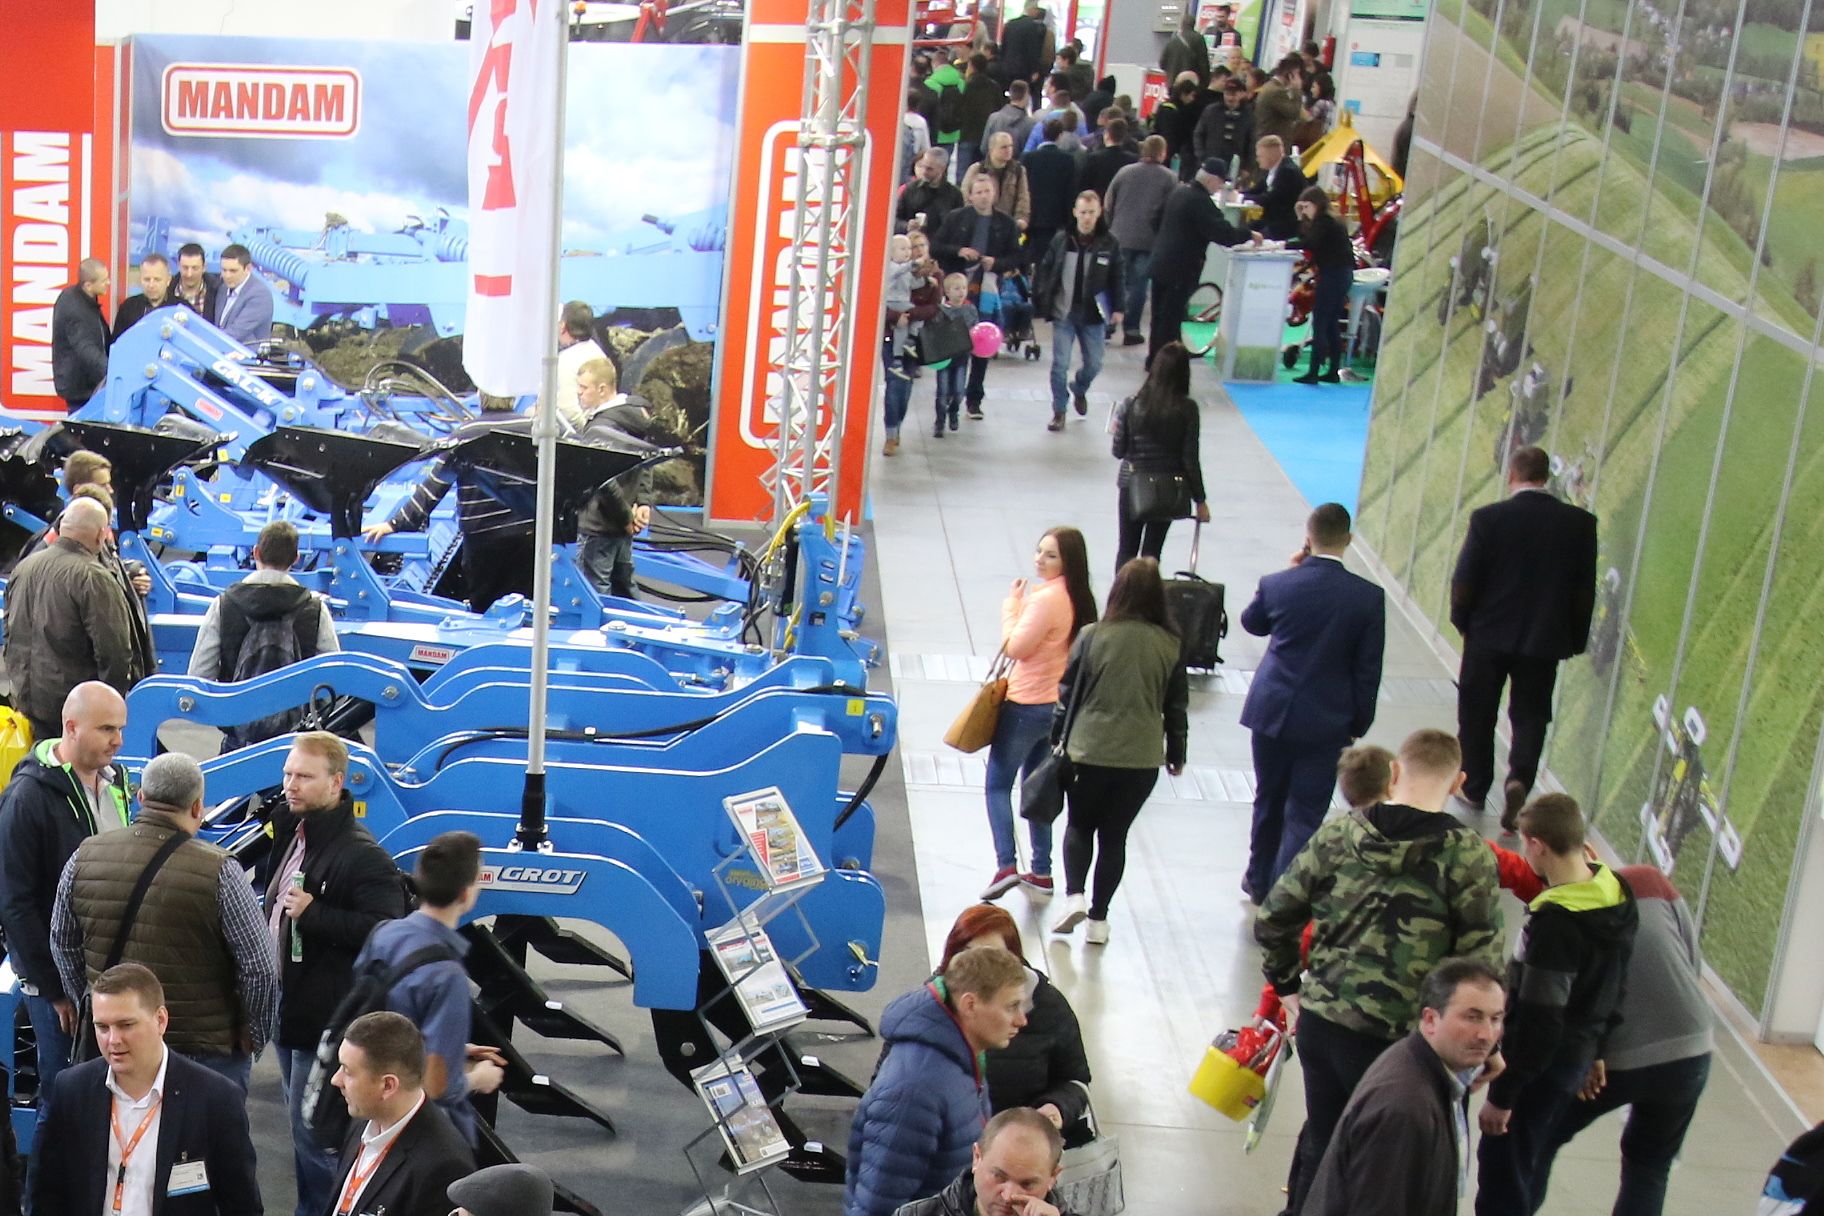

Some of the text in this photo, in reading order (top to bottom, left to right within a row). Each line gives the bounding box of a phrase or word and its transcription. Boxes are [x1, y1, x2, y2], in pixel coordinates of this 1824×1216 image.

[178, 80, 345, 122] MANDAM
[12, 131, 70, 396] MANDAM
[501, 867, 581, 884] GROT
